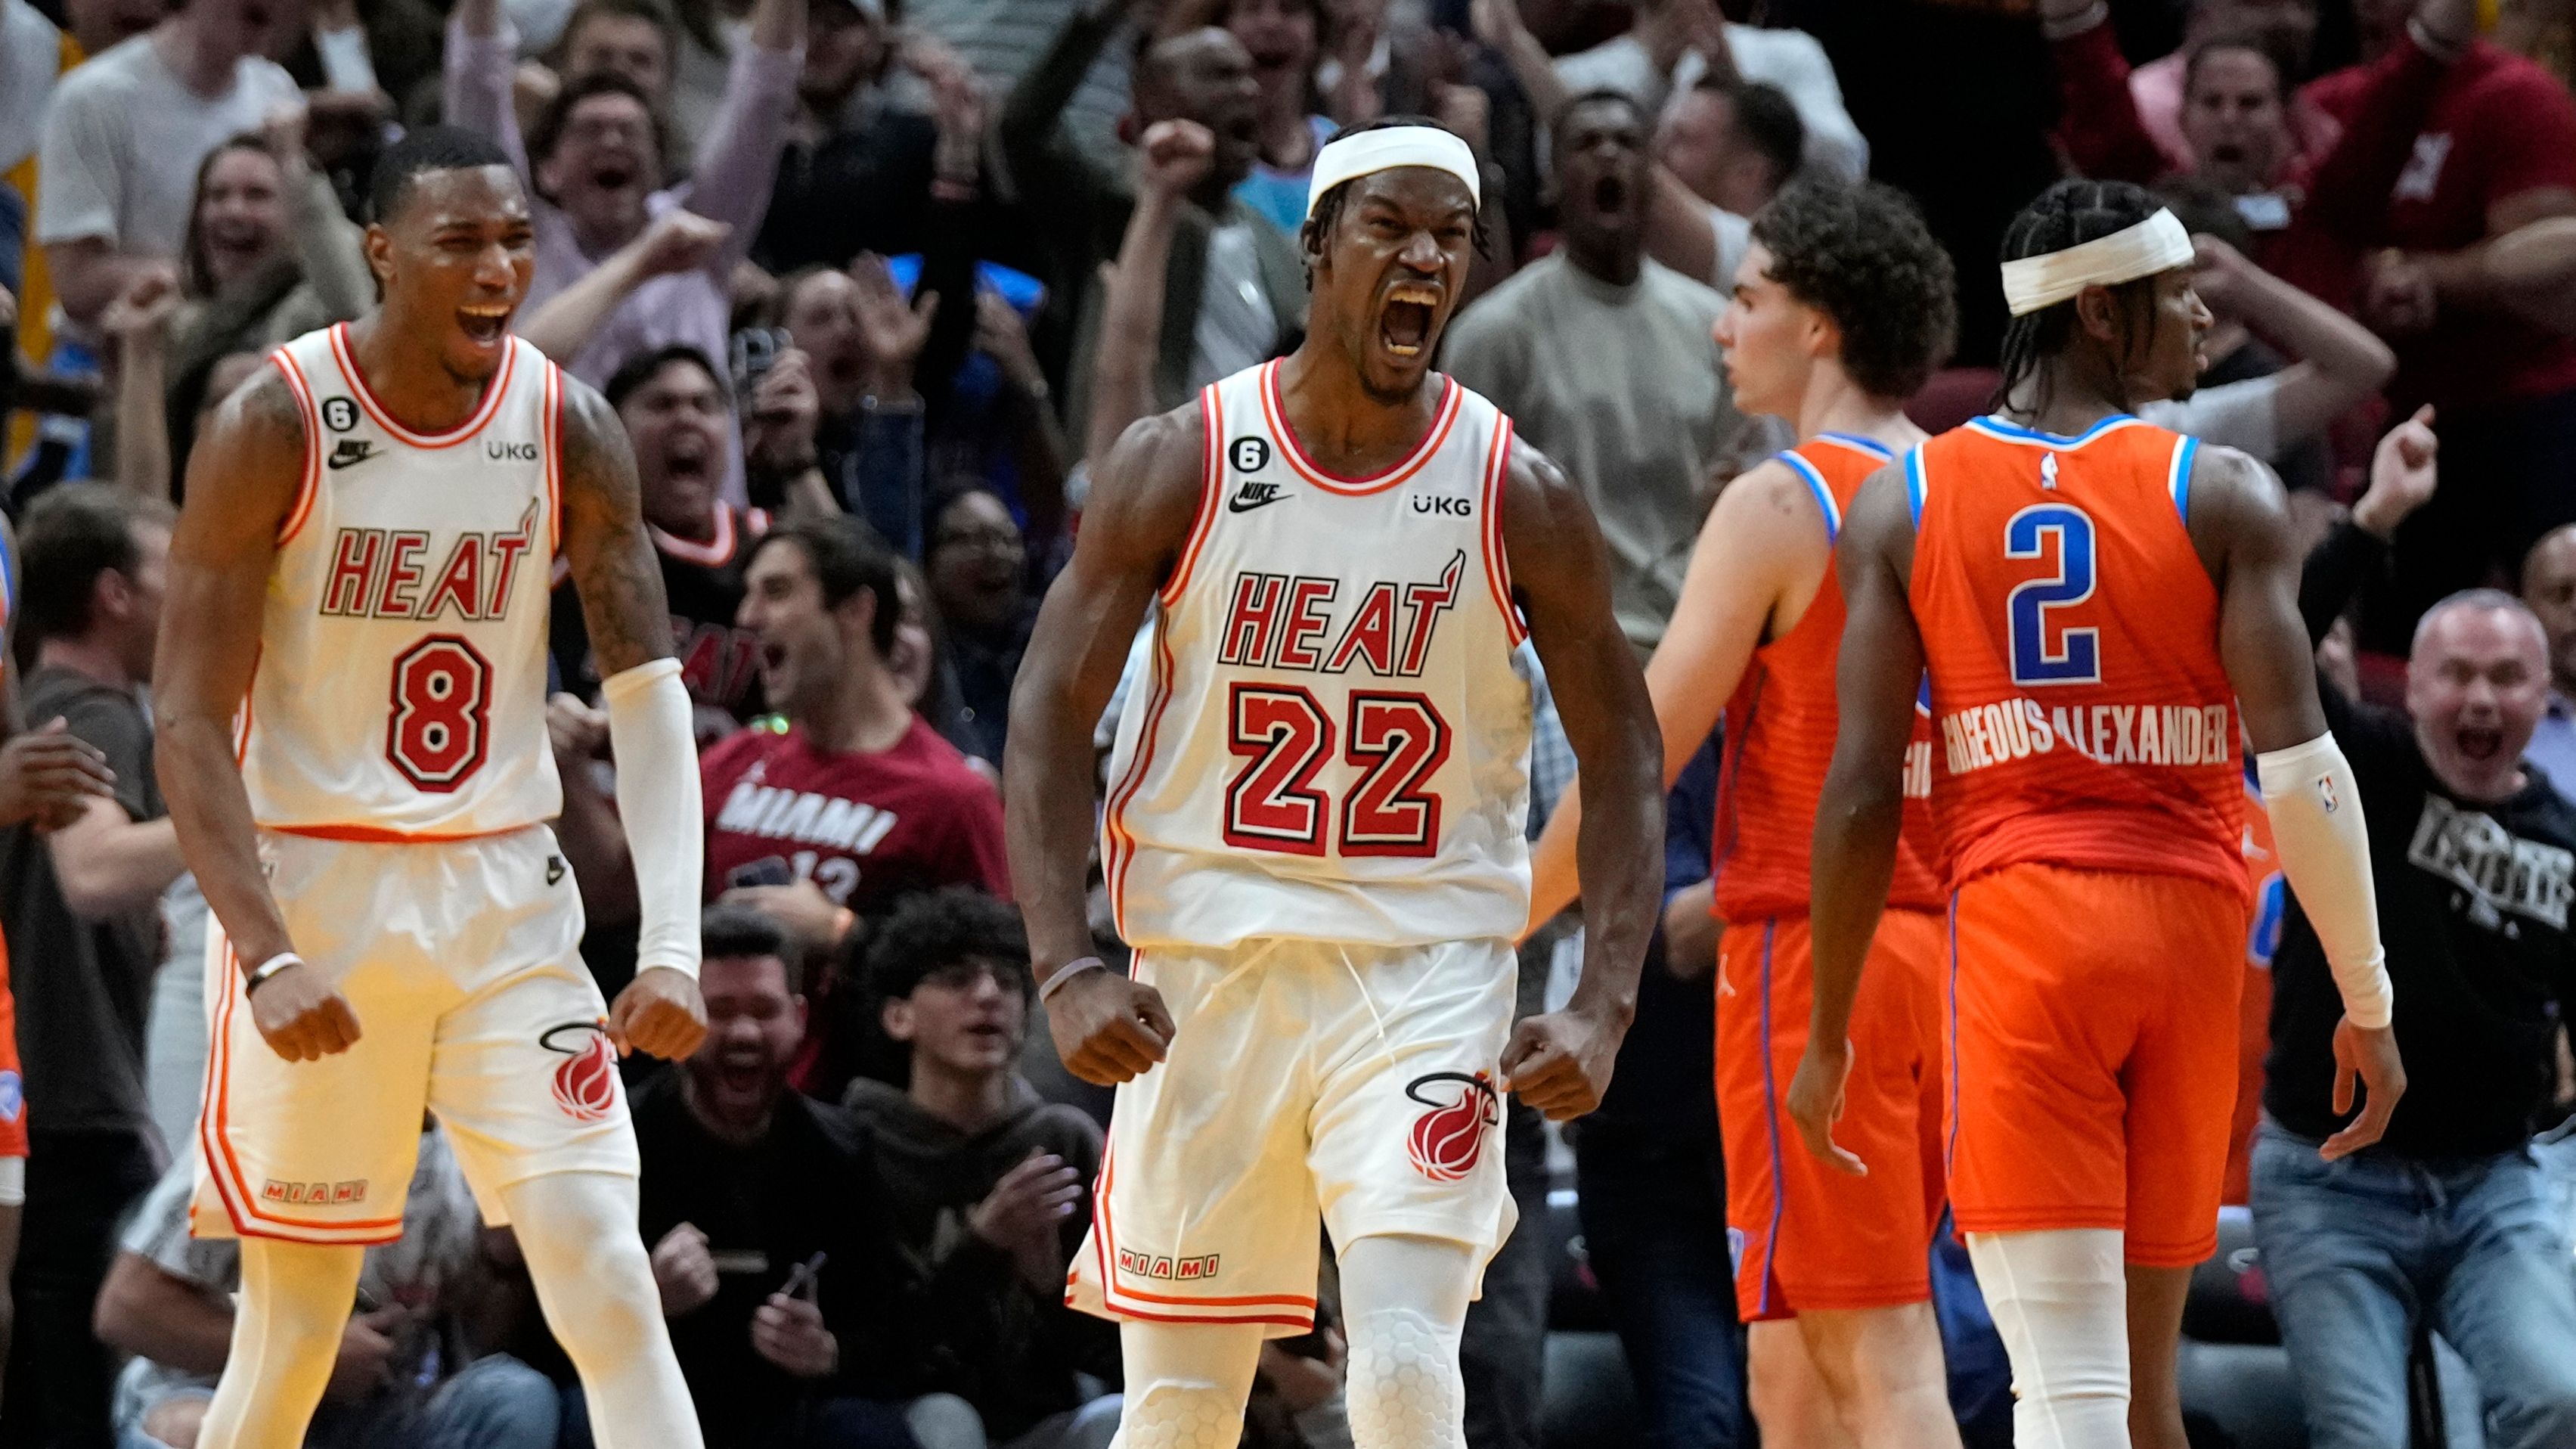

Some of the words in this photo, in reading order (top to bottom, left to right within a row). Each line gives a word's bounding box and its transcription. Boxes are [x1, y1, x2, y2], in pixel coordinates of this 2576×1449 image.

[327, 398, 352, 430] 6
[1238, 439, 1262, 470] 6
[1238, 481, 1281, 501] NIKE
[319, 496, 540, 622] HEAT
[2004, 502, 2101, 687] 2
[1217, 548, 1466, 678] HEAT
[385, 631, 494, 794] 8
[1223, 681, 1452, 858] 22
[715, 780, 898, 856] MIAMI
[262, 1178, 370, 1205] MIAMI
[1118, 1247, 1220, 1280] MIAMI
